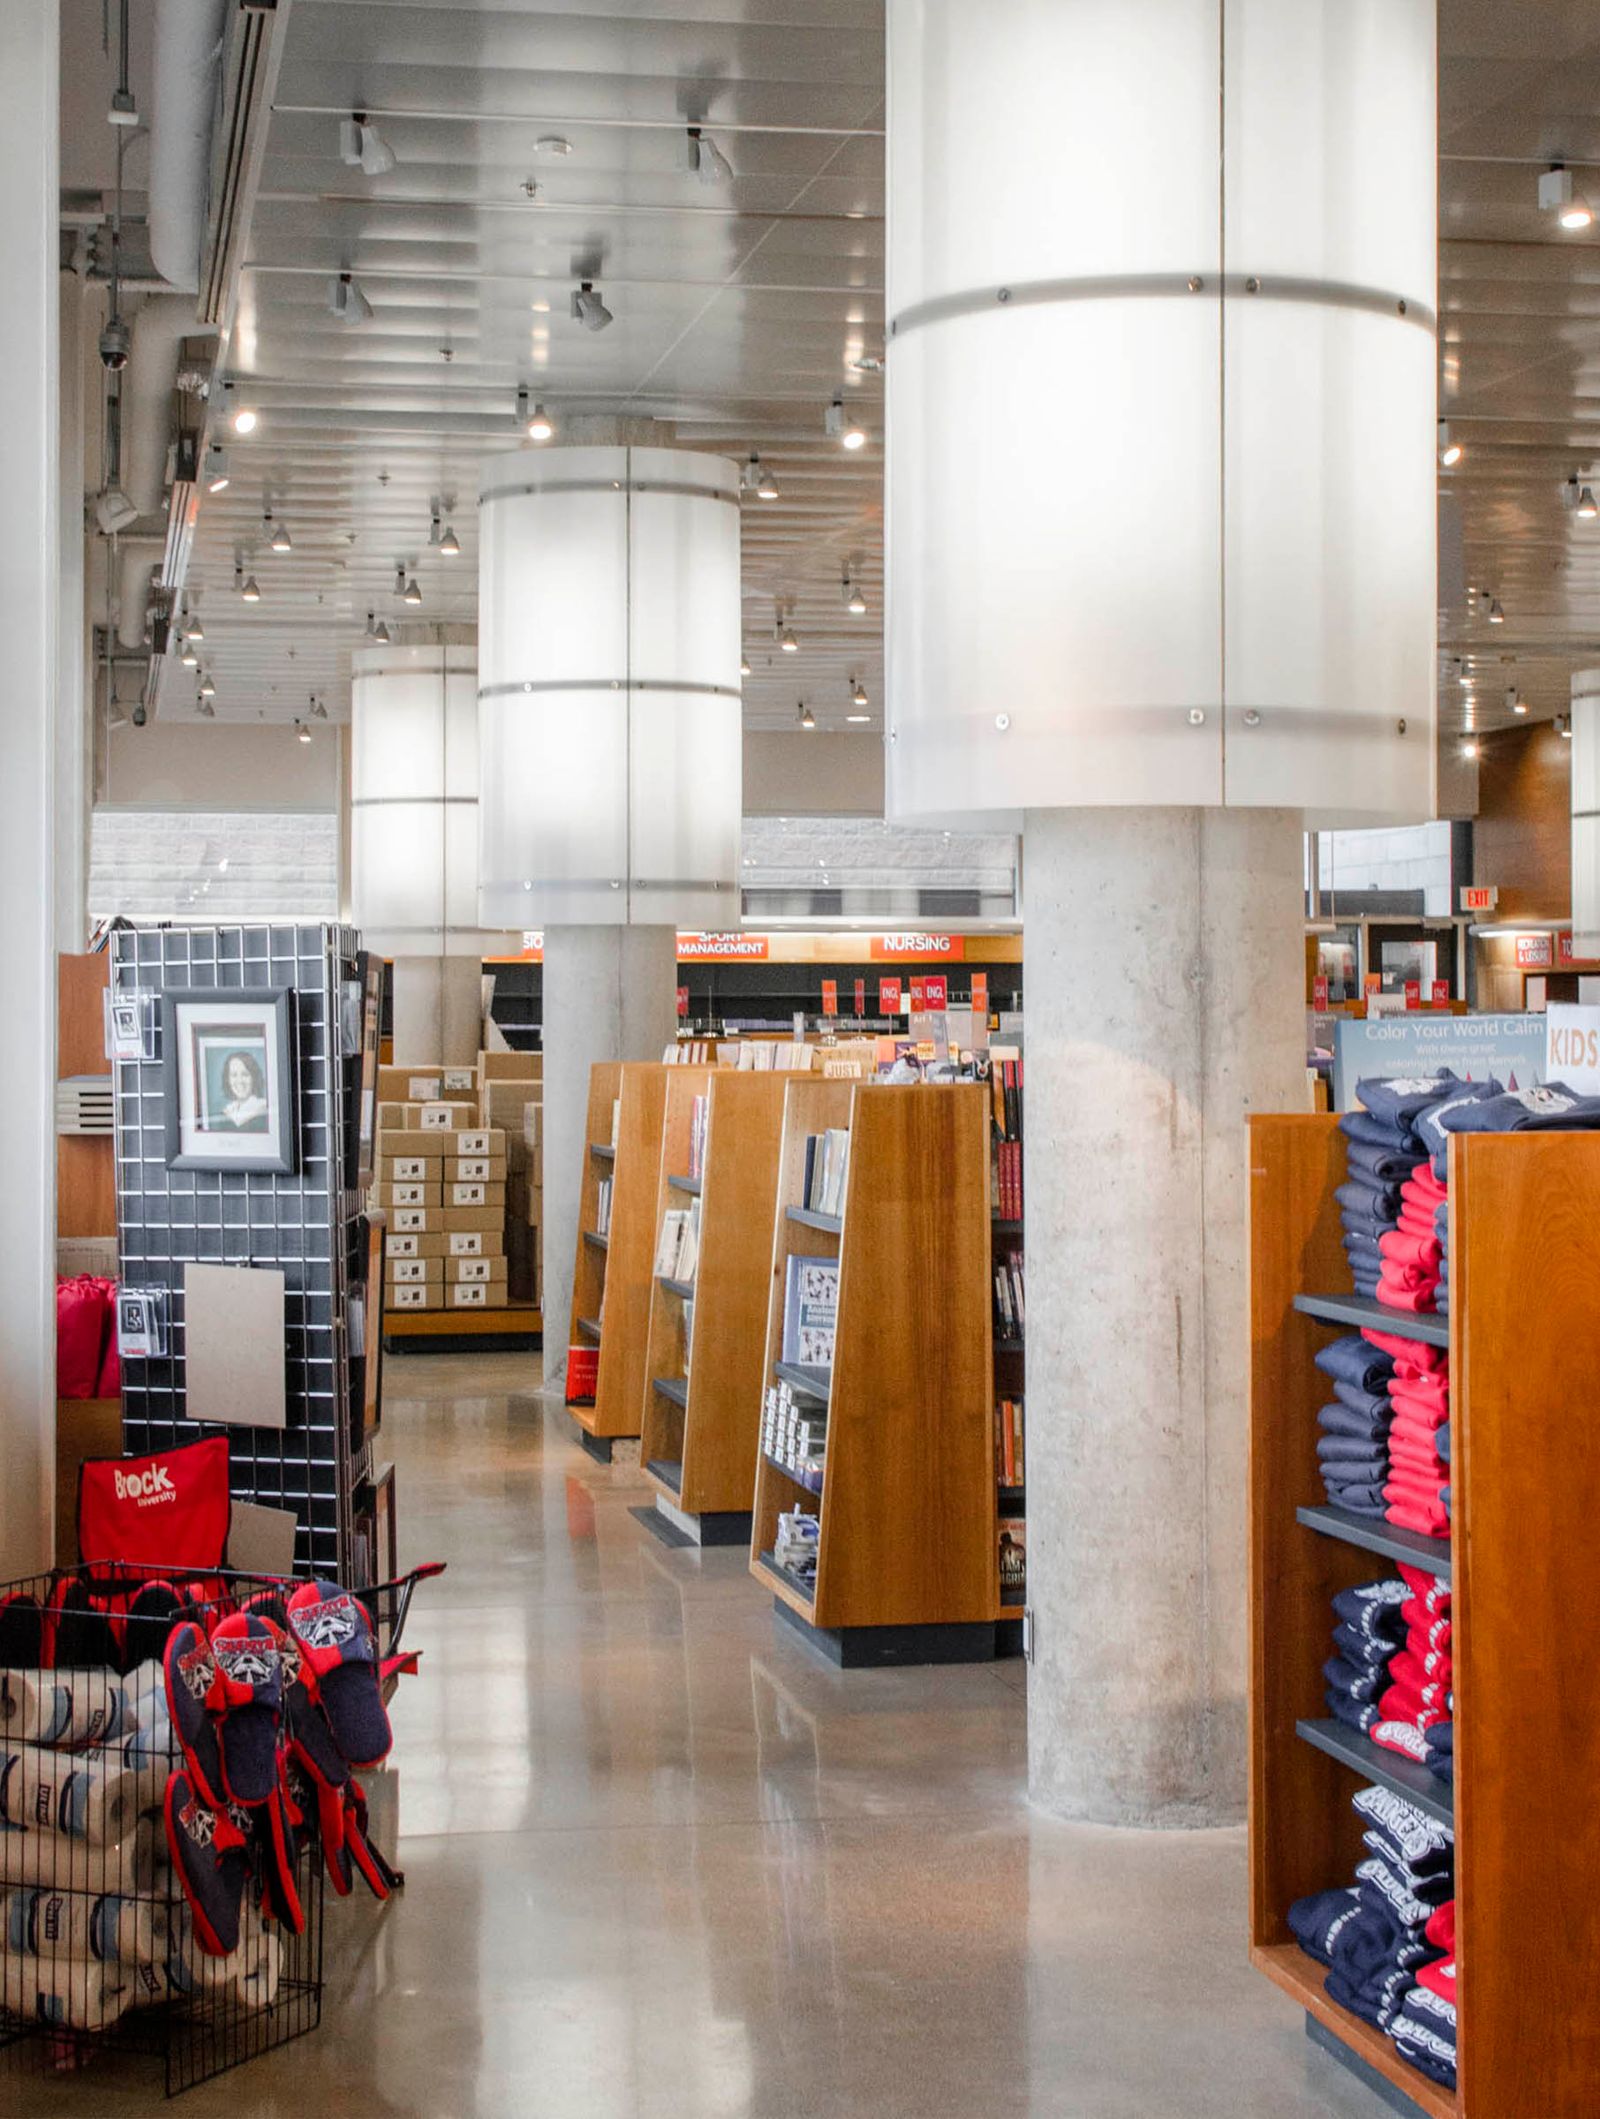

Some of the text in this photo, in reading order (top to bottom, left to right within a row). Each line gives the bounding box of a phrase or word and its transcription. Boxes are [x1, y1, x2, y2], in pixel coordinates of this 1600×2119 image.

[1467, 889, 1489, 908] EXIT
[677, 942, 764, 955] MANAGEMENT
[883, 936, 951, 952] NURSING
[1365, 1020, 1544, 1041] Color Your World Calm
[1551, 1028, 1599, 1068] KIDS
[827, 1063, 856, 1078] JUST
